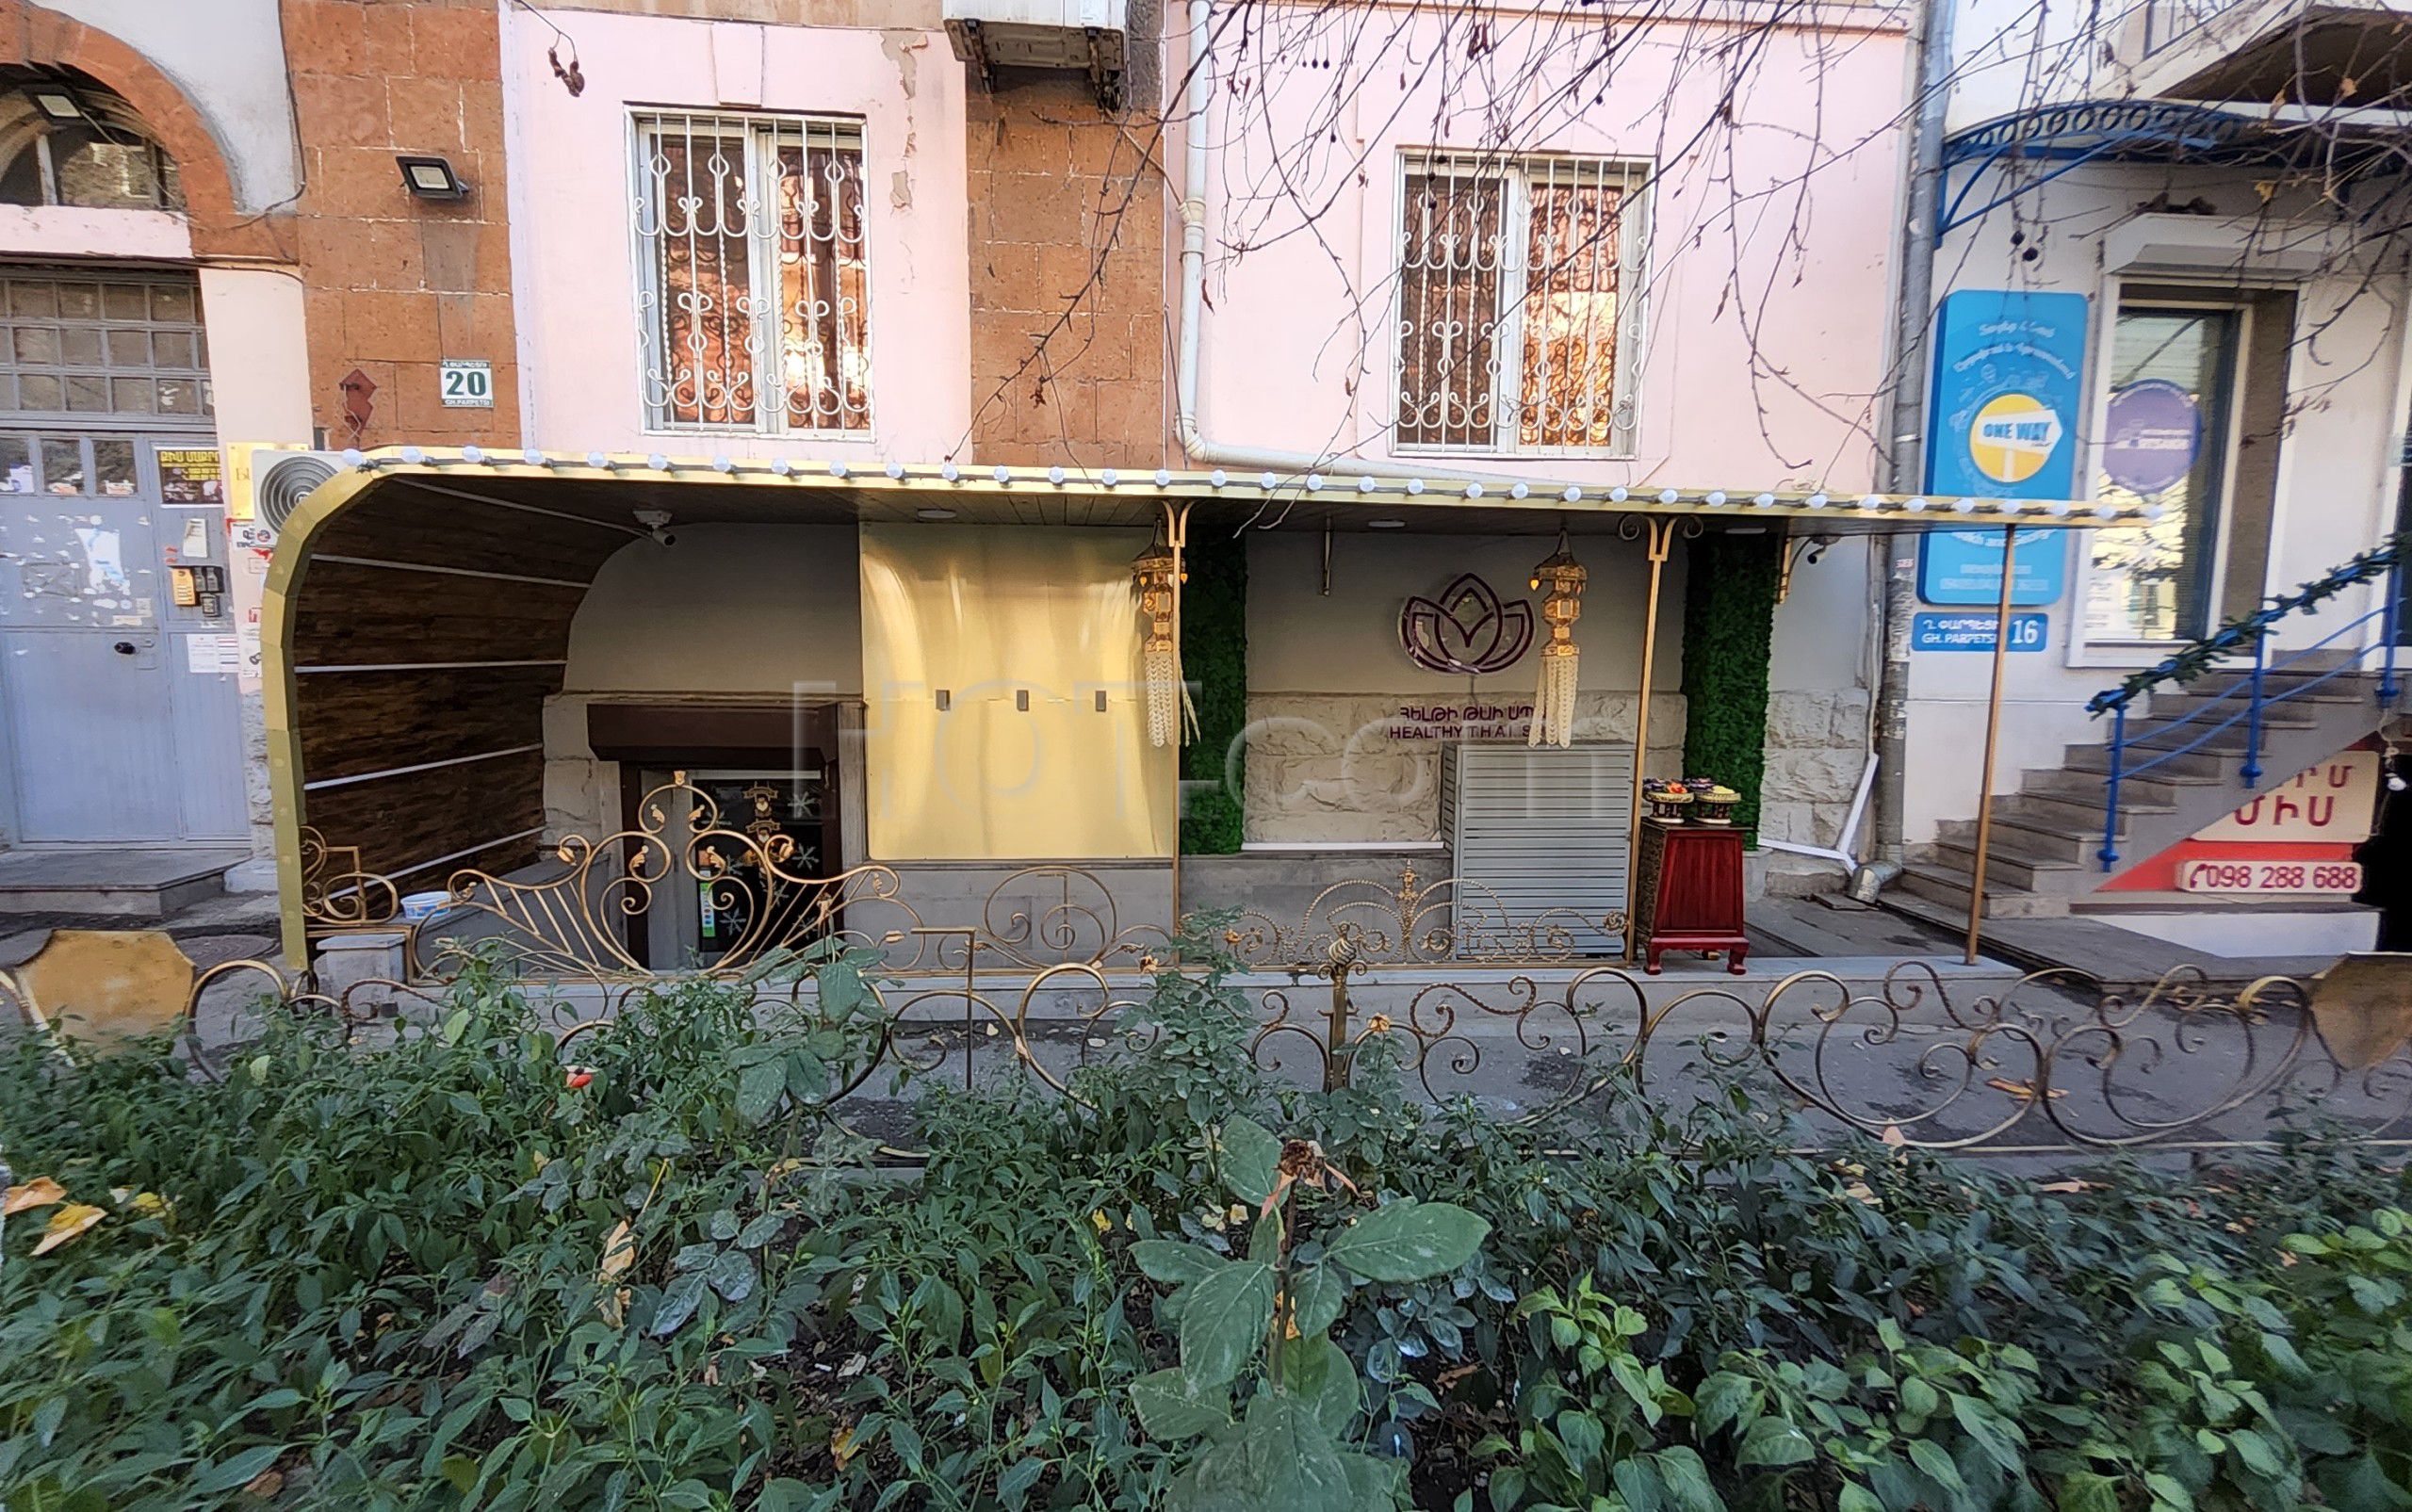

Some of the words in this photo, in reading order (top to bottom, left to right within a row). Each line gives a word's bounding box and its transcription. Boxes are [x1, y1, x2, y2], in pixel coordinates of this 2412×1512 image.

[446, 370, 486, 397] 20
[1982, 422, 2014, 439] ONE
[2016, 421, 2052, 442] WAY
[2012, 619, 2039, 644] 16
[1508, 706, 1547, 721] ՍՊ
[1390, 725, 1462, 740] HEALTHY
[1468, 724, 1513, 739] THAI
[2206, 865, 2252, 888] 098
[2259, 865, 2306, 888] 288
[2313, 865, 2357, 888] 688
